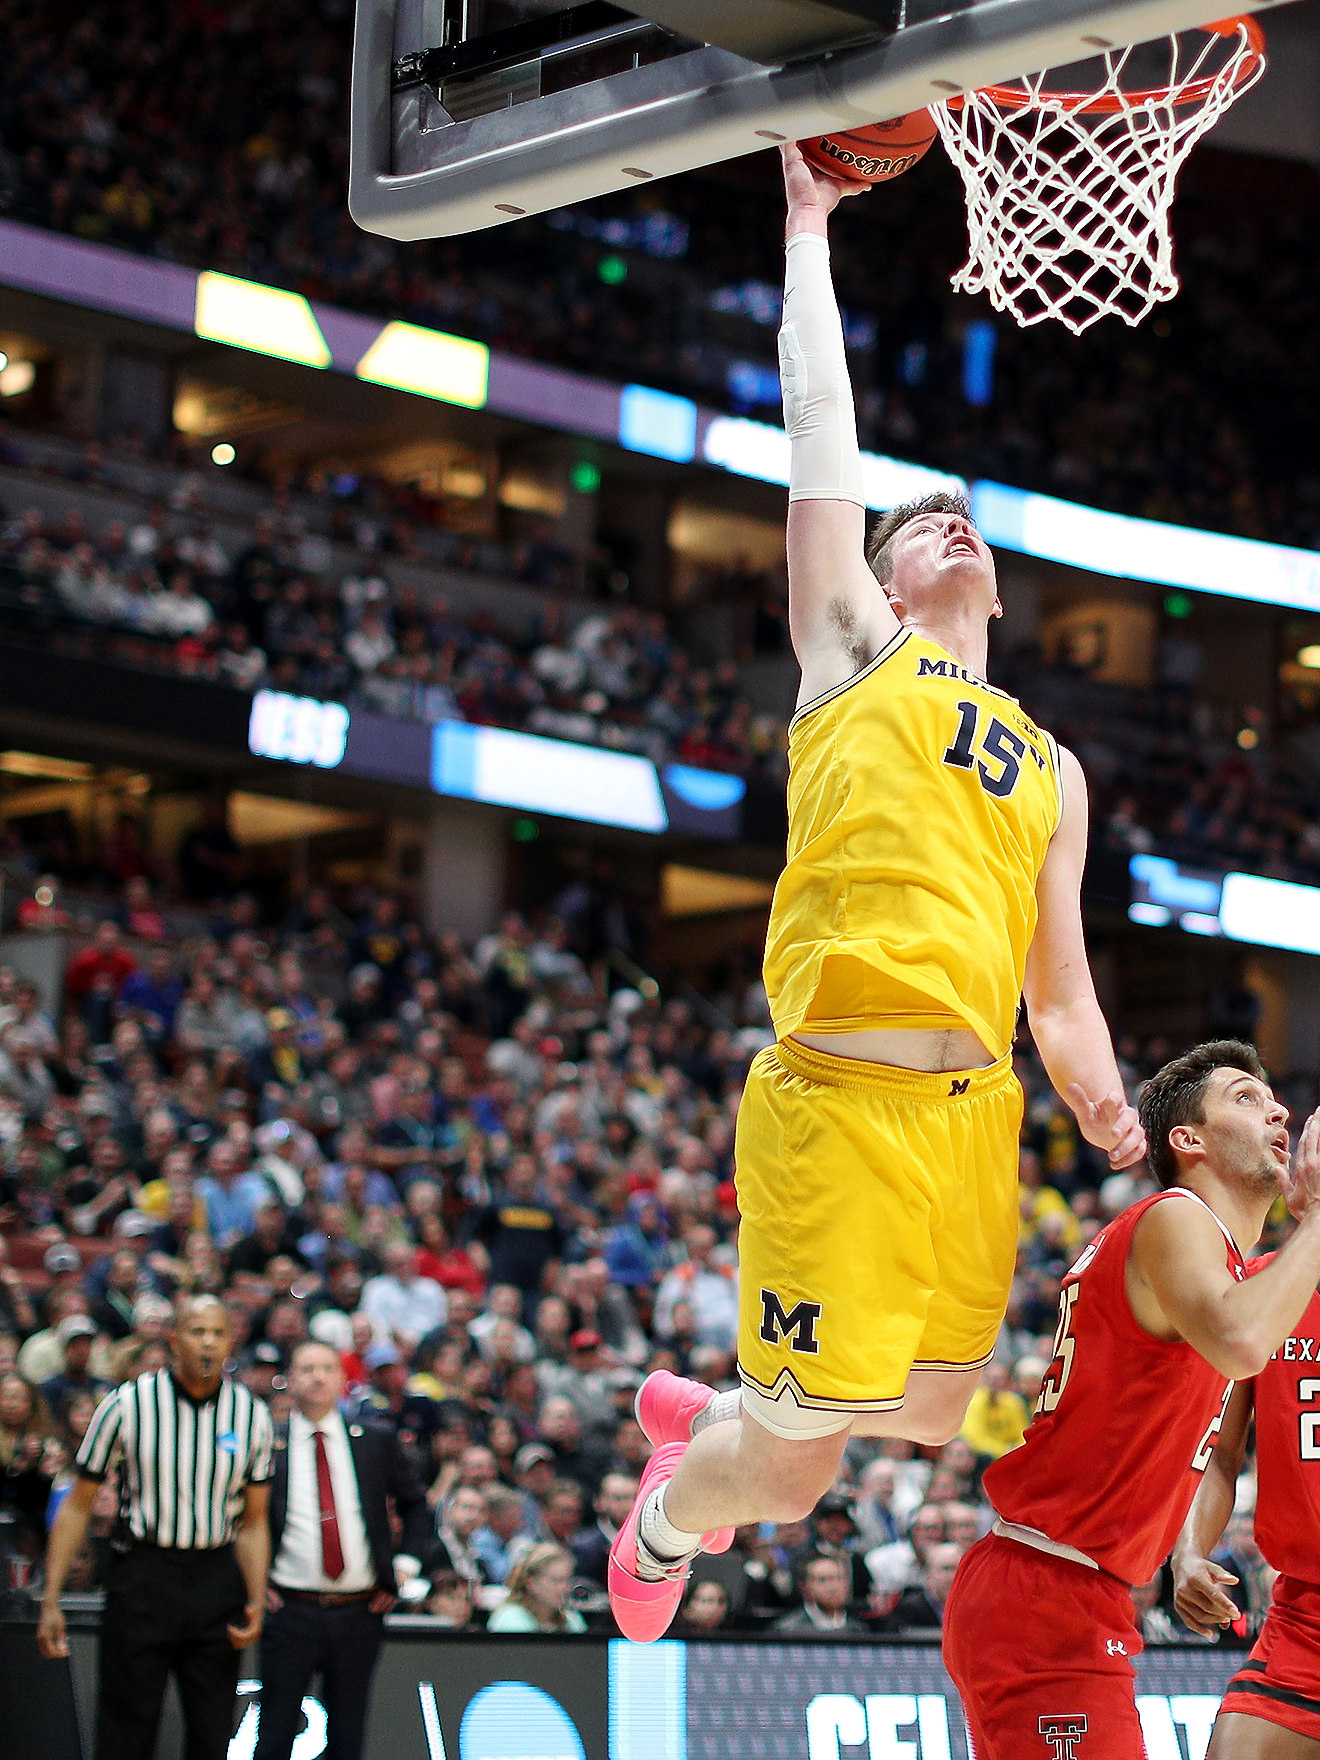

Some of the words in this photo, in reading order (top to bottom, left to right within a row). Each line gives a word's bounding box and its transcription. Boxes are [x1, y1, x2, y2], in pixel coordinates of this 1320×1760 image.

[818, 136, 919, 176] Wilson
[942, 701, 1026, 799] 15
[948, 1079, 970, 1096] M
[759, 1287, 823, 1354] M
